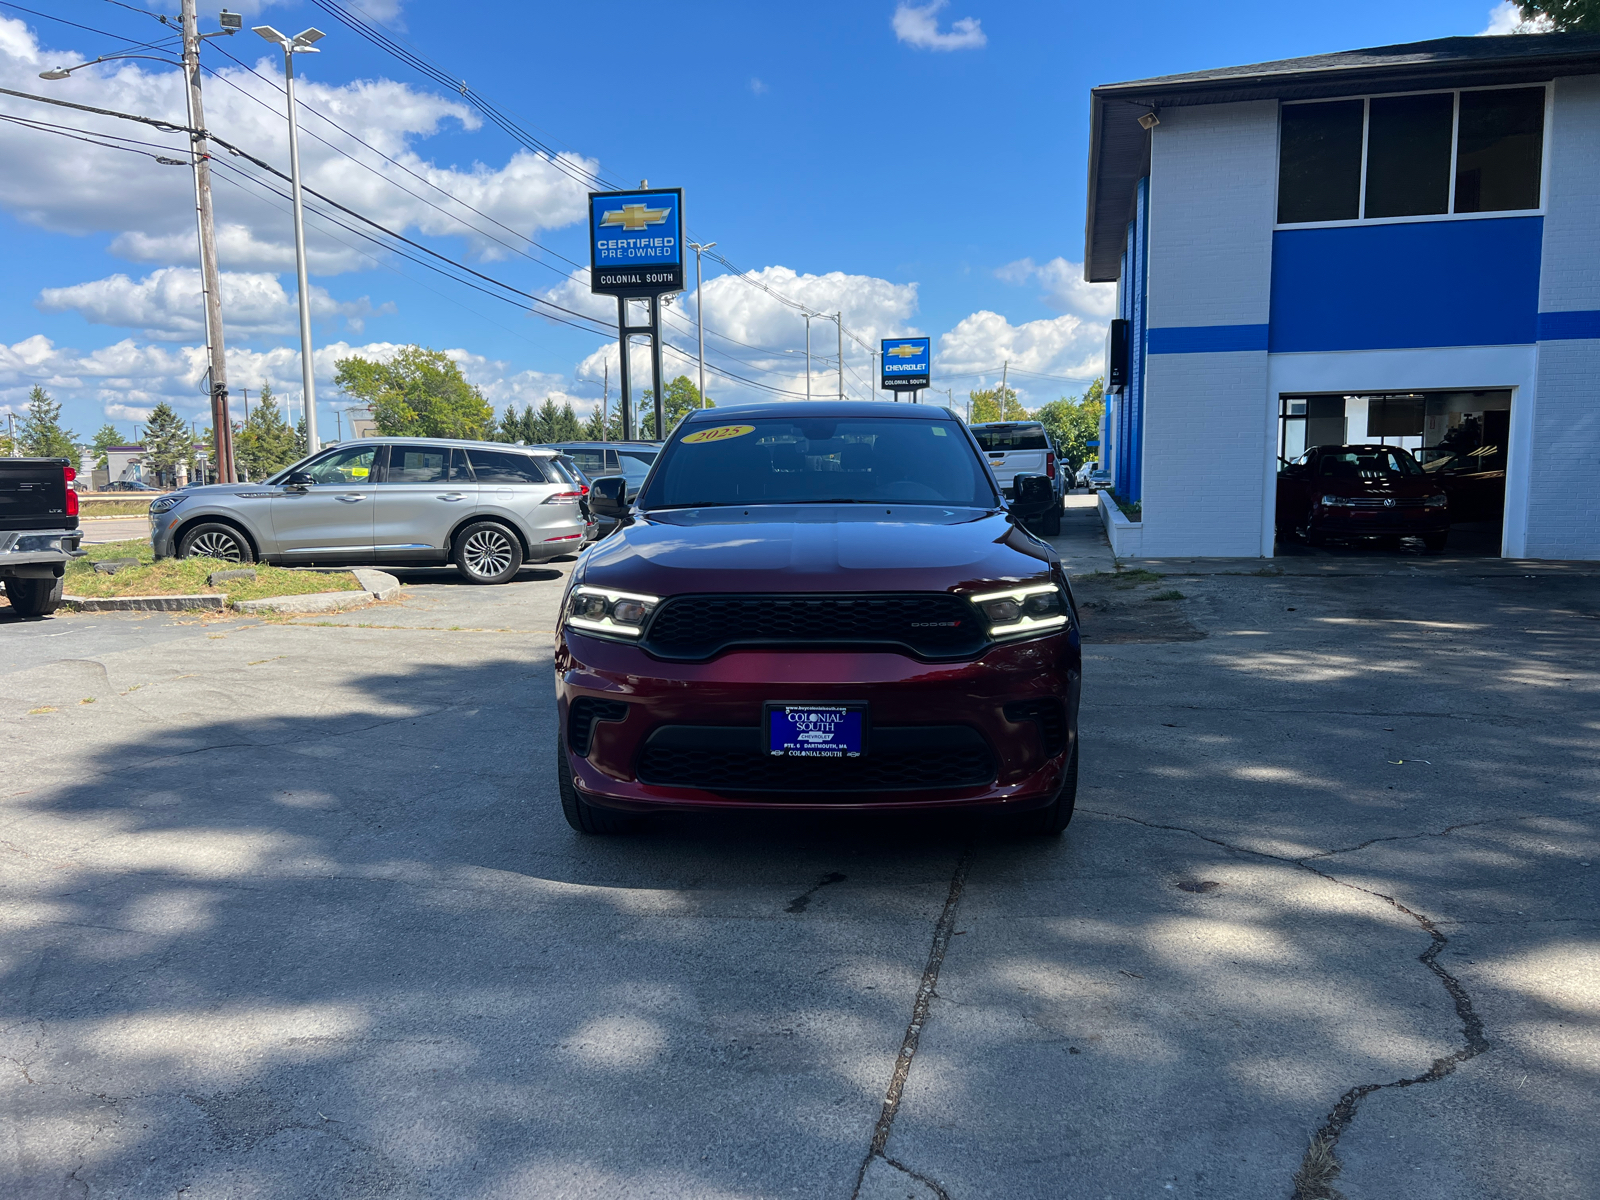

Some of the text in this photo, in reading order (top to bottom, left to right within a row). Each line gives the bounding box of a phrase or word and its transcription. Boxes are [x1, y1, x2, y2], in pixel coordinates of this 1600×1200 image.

[597, 237, 675, 249] CERTIFIED
[601, 247, 671, 258] PRE-OWNED
[600, 273, 673, 284] COLONIAL SOUTH
[885, 363, 926, 371] CHEVROLET
[692, 426, 744, 442] 2025
[788, 713, 843, 722] COLONIAL
[796, 722, 834, 731] SOUTH
